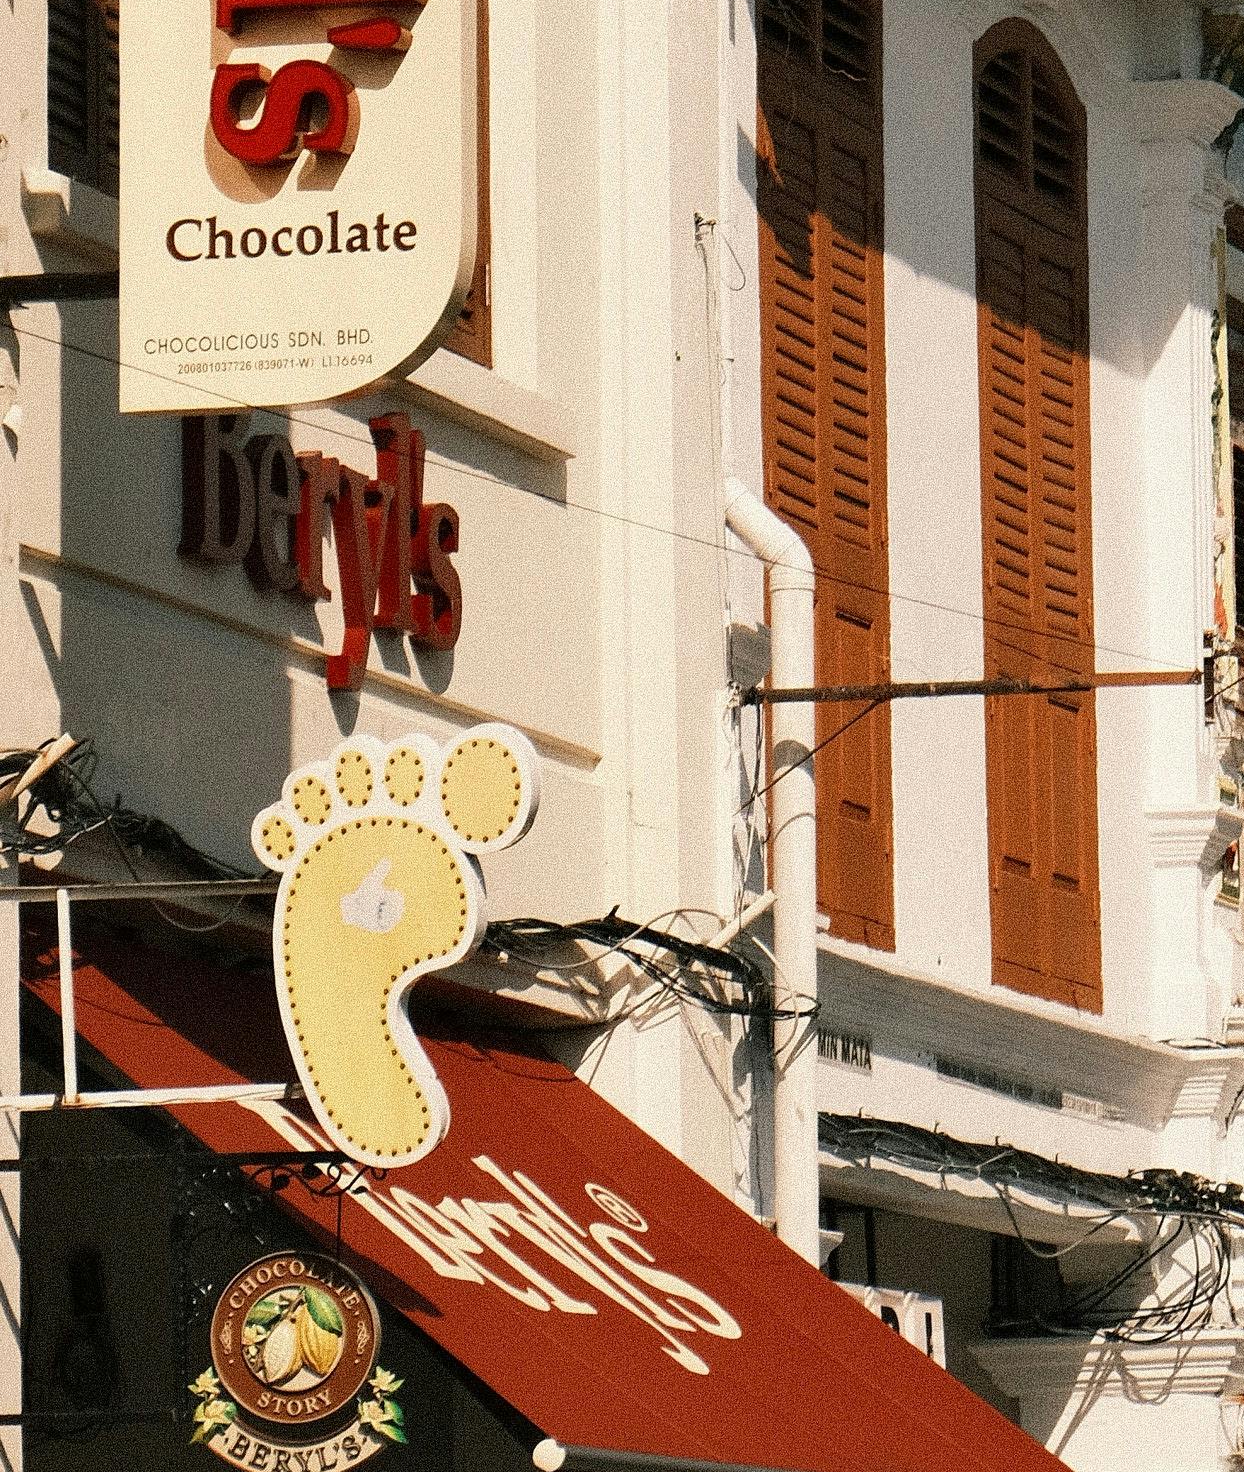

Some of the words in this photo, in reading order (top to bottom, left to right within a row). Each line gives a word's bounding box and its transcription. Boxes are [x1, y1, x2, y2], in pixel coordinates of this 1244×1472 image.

[164, 211, 418, 264] Chocolate
[143, 332, 279, 355] CHOCOLICIOUS
[288, 331, 326, 348] SDN.
[337, 328, 374, 346] BHD.
[229, 1260, 361, 1310] CHOCOLATE
[256, 1389, 332, 1416] STORY
